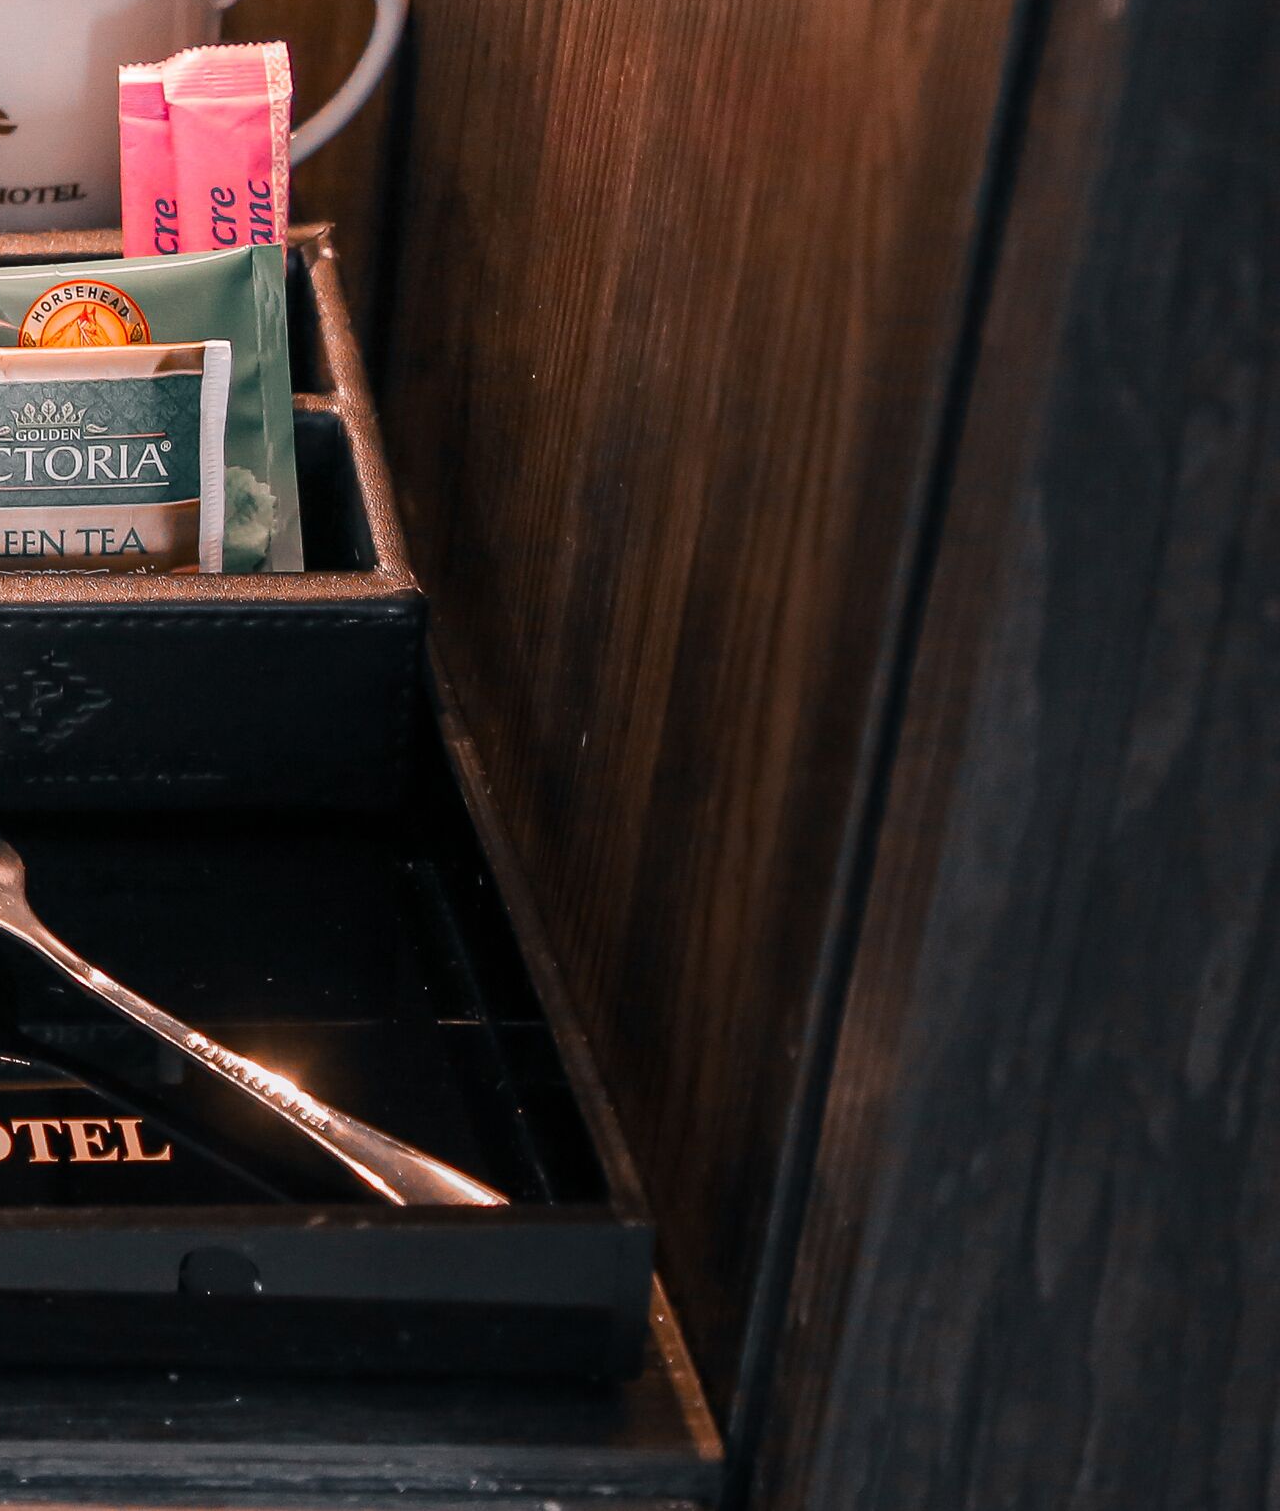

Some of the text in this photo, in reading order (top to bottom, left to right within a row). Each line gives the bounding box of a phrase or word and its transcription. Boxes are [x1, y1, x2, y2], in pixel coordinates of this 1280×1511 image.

[154, 198, 179, 255] cre
[210, 187, 238, 250] cre
[248, 179, 273, 245] anc
[32, 286, 130, 323] HORSEHEAD
[15, 427, 82, 442] GOLDEN
[75, 526, 148, 556] TEA
